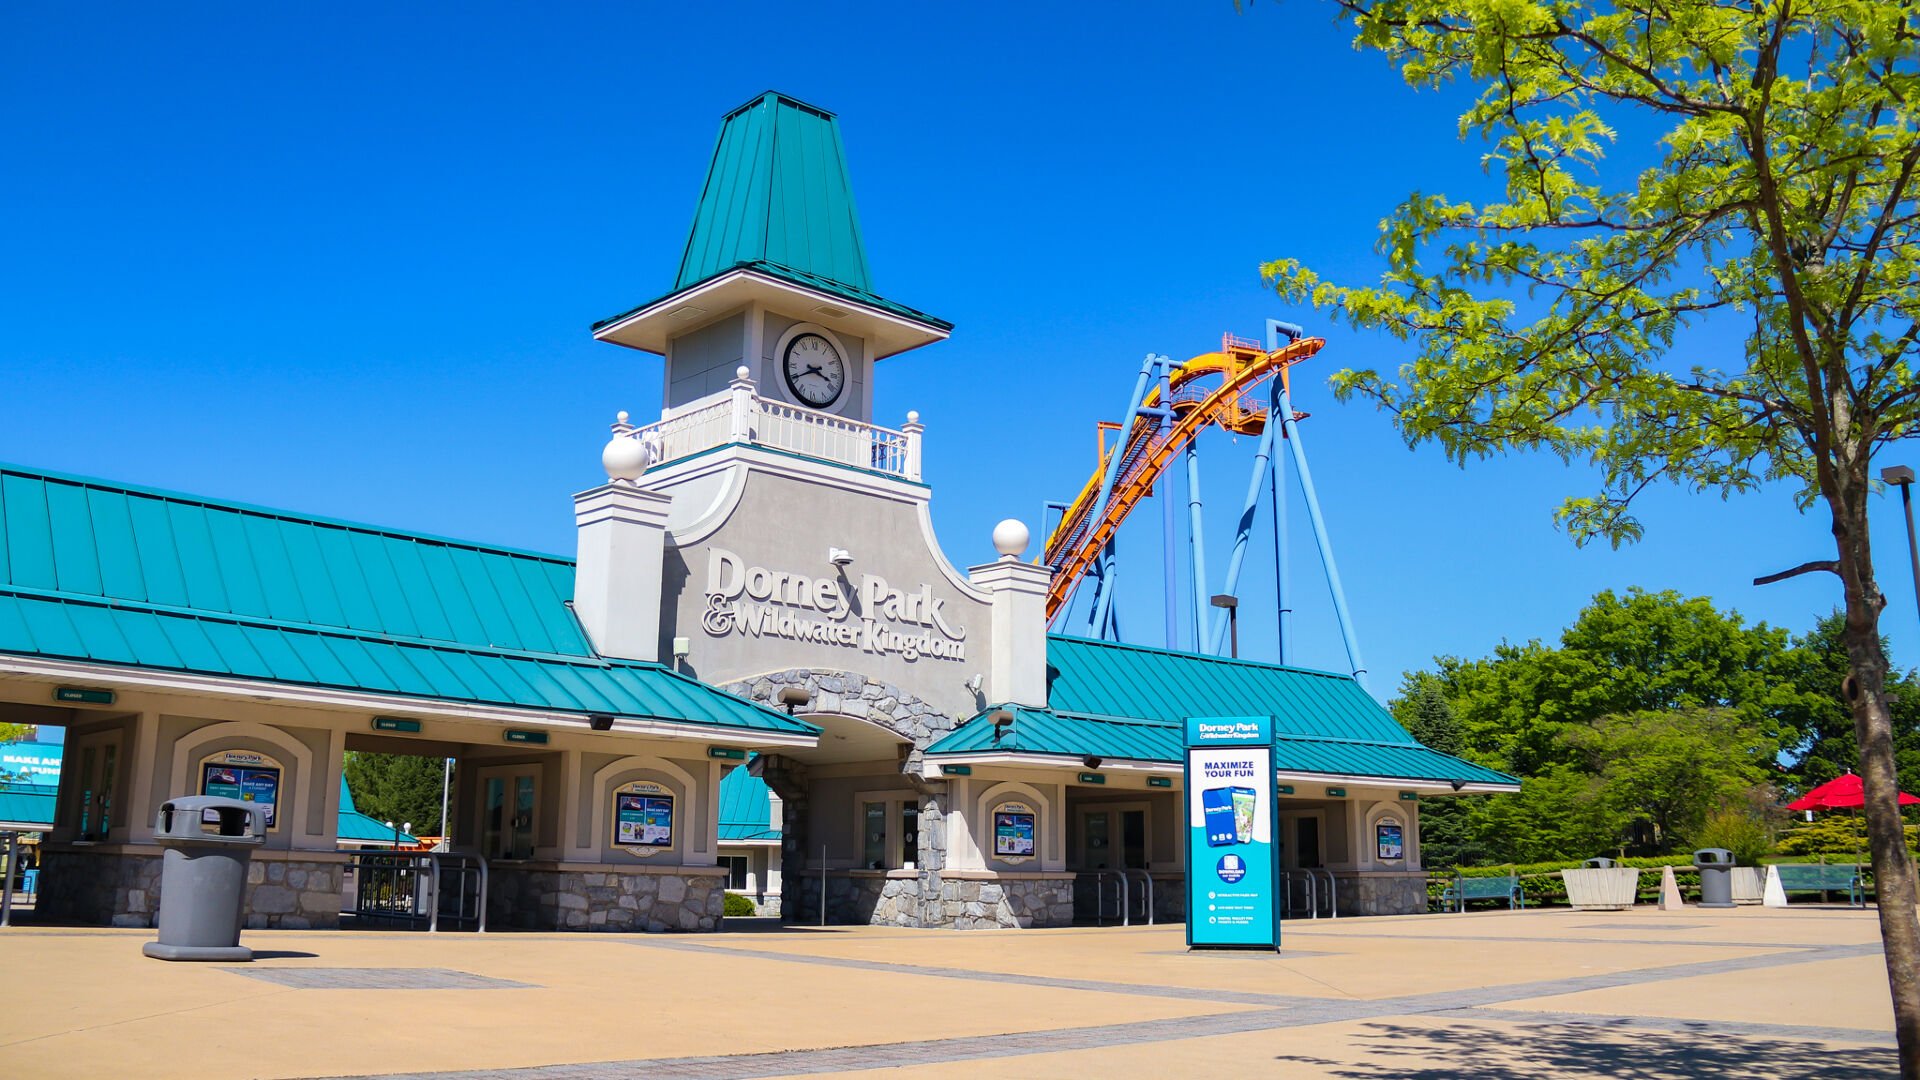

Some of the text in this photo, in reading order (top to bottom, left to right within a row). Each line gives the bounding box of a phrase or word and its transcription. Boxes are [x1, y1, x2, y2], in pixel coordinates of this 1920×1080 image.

[705, 547, 966, 640] Dorney Park
[701, 593, 966, 662] & Wildwater Kingdom
[1199, 722, 1259, 733] Dorney Park
[3, 755, 39, 765] MAKE
[1204, 761, 1254, 770] MAXIMIZE
[1204, 769, 1254, 778] YOUR FUN
